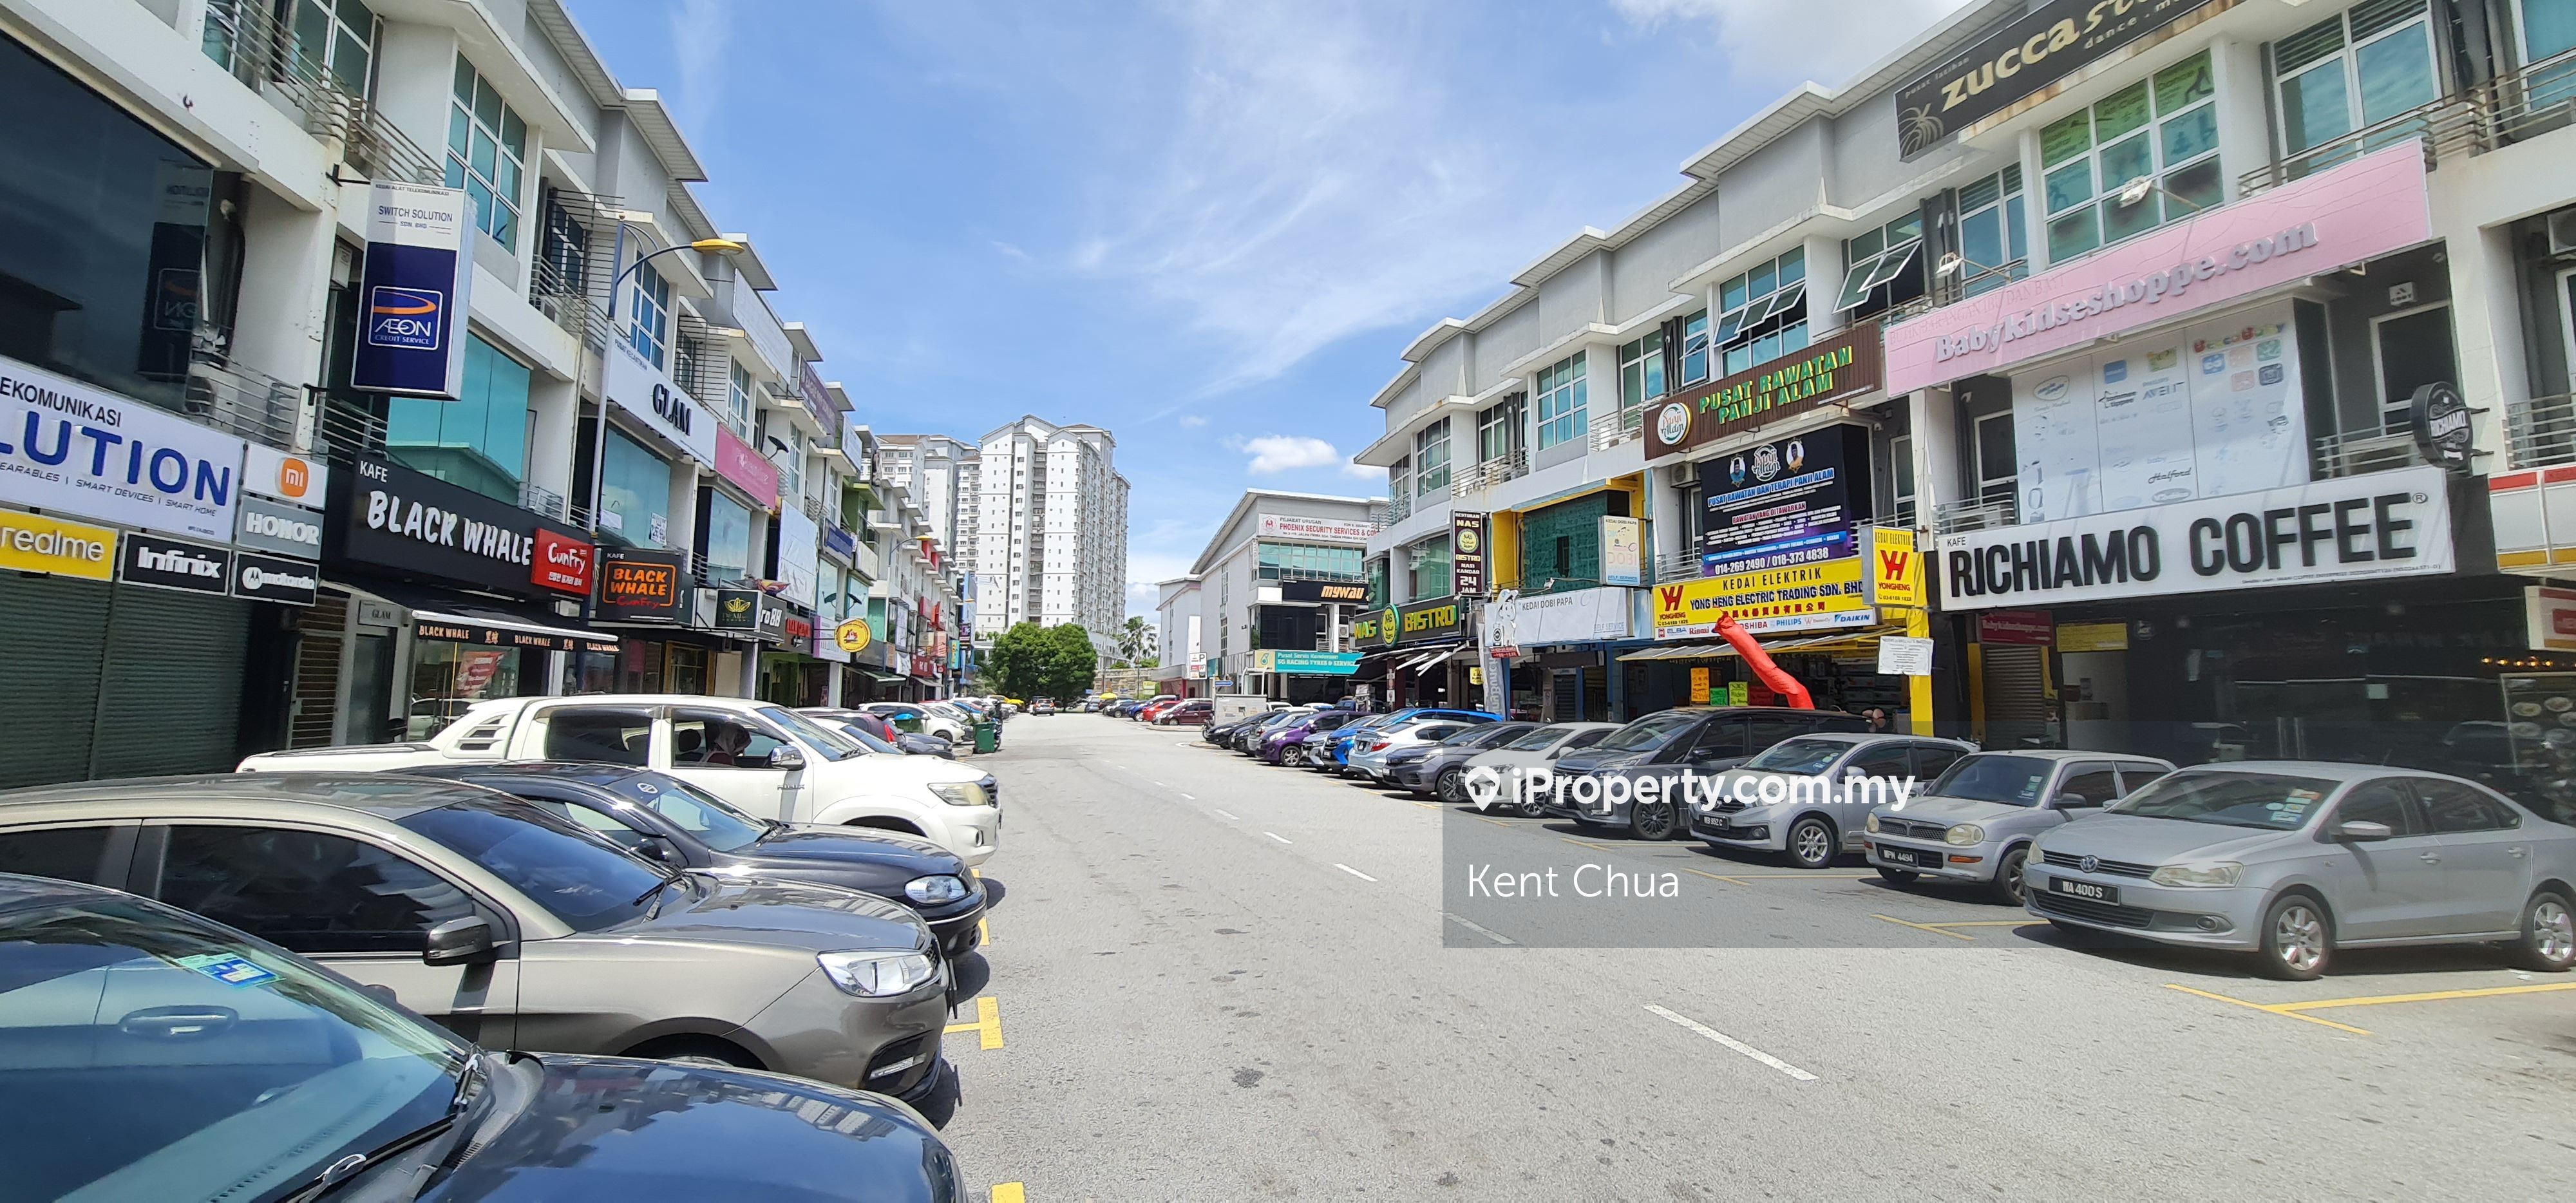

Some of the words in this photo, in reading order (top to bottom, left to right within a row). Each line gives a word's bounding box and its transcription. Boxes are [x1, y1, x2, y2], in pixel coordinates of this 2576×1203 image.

[2084, 17, 2137, 50] dance
[1941, 17, 2079, 112] zucca
[379, 205, 410, 218] SWITCH
[412, 209, 453, 222] SOLUTION
[1936, 222, 2318, 363] Babykidseshoppe.com
[375, 334, 400, 343] CREDIT
[1700, 381, 1753, 414] PUSAT
[1759, 345, 1853, 393] RAWATAN
[0, 377, 122, 428] EKOMUNIKASI
[652, 383, 692, 437] GLAM
[1718, 393, 1771, 424] PANJI
[1777, 372, 1833, 406] ALAM
[0, 411, 230, 506] UTION
[359, 460, 388, 484] KAFE
[0, 462, 60, 482] EARABLES
[76, 478, 113, 494] SMART
[115, 488, 154, 503] DEVICES
[166, 499, 193, 511] SMART
[195, 506, 216, 516] HOME
[1708, 495, 1727, 507] PUSAT
[1727, 489, 1756, 503] RAWATAN
[1771, 478, 1793, 492] TERAPI
[1814, 468, 1834, 482] ALAM
[246, 512, 319, 545] HONOR
[367, 491, 457, 547] BLACK
[463, 518, 534, 566] WHALE
[1280, 523, 1305, 532] PHOENIX
[1306, 525, 1332, 534] SECURITY
[1334, 527, 1360, 536] SERVICES
[1, 526, 105, 562] realme
[1947, 537, 1966, 547] KAFE
[1949, 526, 2161, 598] RICHIAMO
[2190, 493, 2417, 576] COFFEE
[137, 547, 222, 579] Infinix
[1607, 552, 1636, 566] DOBI
[1714, 560, 1745, 575] 014-269
[1746, 557, 1766, 571] 2490
[1772, 552, 1804, 567] 018-373
[613, 568, 668, 583] BLACK
[1459, 576, 1477, 585] 24
[1723, 575, 1756, 591] KEDAI
[1762, 567, 1822, 587] ELEKTRIK
[1879, 582, 1910, 591] YONGHENG
[611, 582, 668, 596] WHALE
[1690, 598, 1711, 611] YONG
[1712, 594, 1734, 607] HENG
[1735, 590, 1775, 606] ELECTRIC
[1777, 585, 1817, 602] TRADING
[1819, 583, 1842, 596] SDN.
[1522, 600, 1540, 611] KEDAI
[1540, 598, 1555, 609] DOBI
[1557, 596, 1573, 607] PAPA
[419, 625, 444, 637] BLACK
[446, 627, 469, 639] WHALE
[1355, 620, 1377, 639] NAS
[1405, 605, 1457, 632] BISTRO
[1740, 621, 1767, 629] OSHIBA
[1776, 618, 1802, 627] PHILIPS
[1840, 614, 1870, 622] DAIKIN
[515, 634, 533, 645] BLACK
[533, 636, 551, 647] WHALE
[587, 641, 602, 651] BLACK
[2063, 881, 2074, 893] WA
[2075, 884, 2095, 897] 400
[2096, 887, 2103, 898] S
